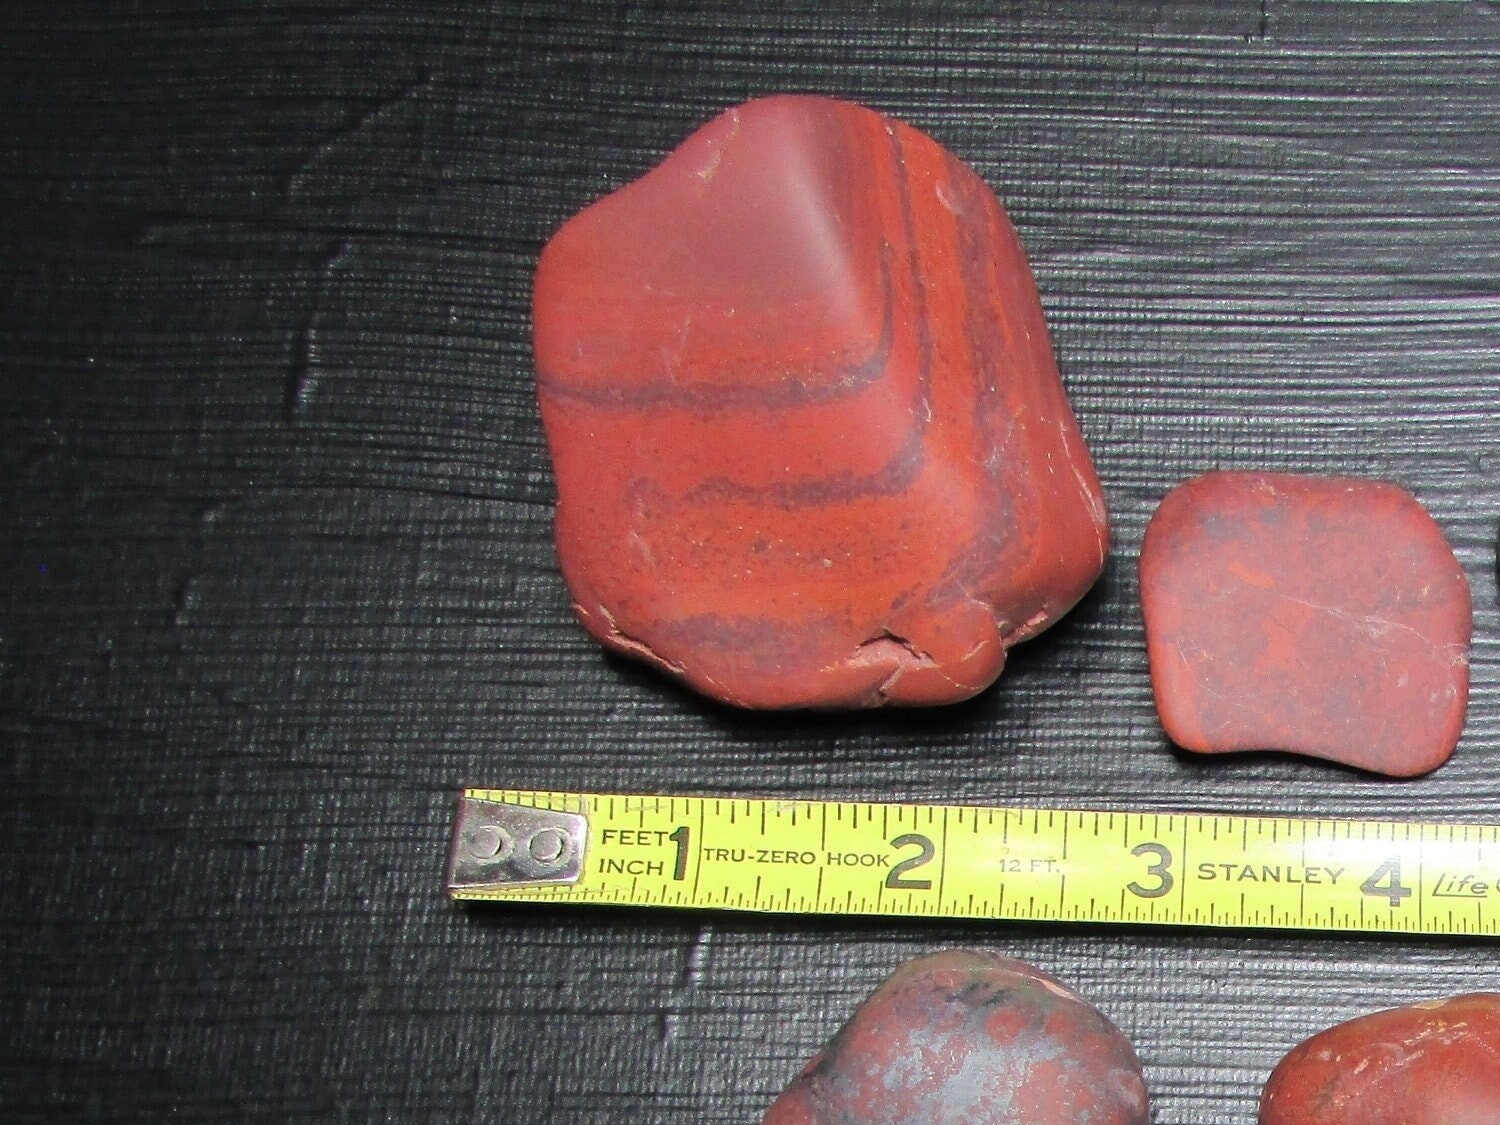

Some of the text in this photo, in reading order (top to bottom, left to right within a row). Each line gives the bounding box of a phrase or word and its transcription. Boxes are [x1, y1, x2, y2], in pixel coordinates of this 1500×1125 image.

[601, 829, 668, 847] FEET
[669, 826, 690, 880] 1
[703, 848, 890, 867] TRU-ZERO HOOK
[885, 833, 936, 890] 2
[599, 858, 664, 876] INCH
[999, 859, 1022, 873] 12
[1126, 842, 1174, 898] 3
[1197, 863, 1345, 885] STANLEY
[1360, 858, 1412, 908] 4
